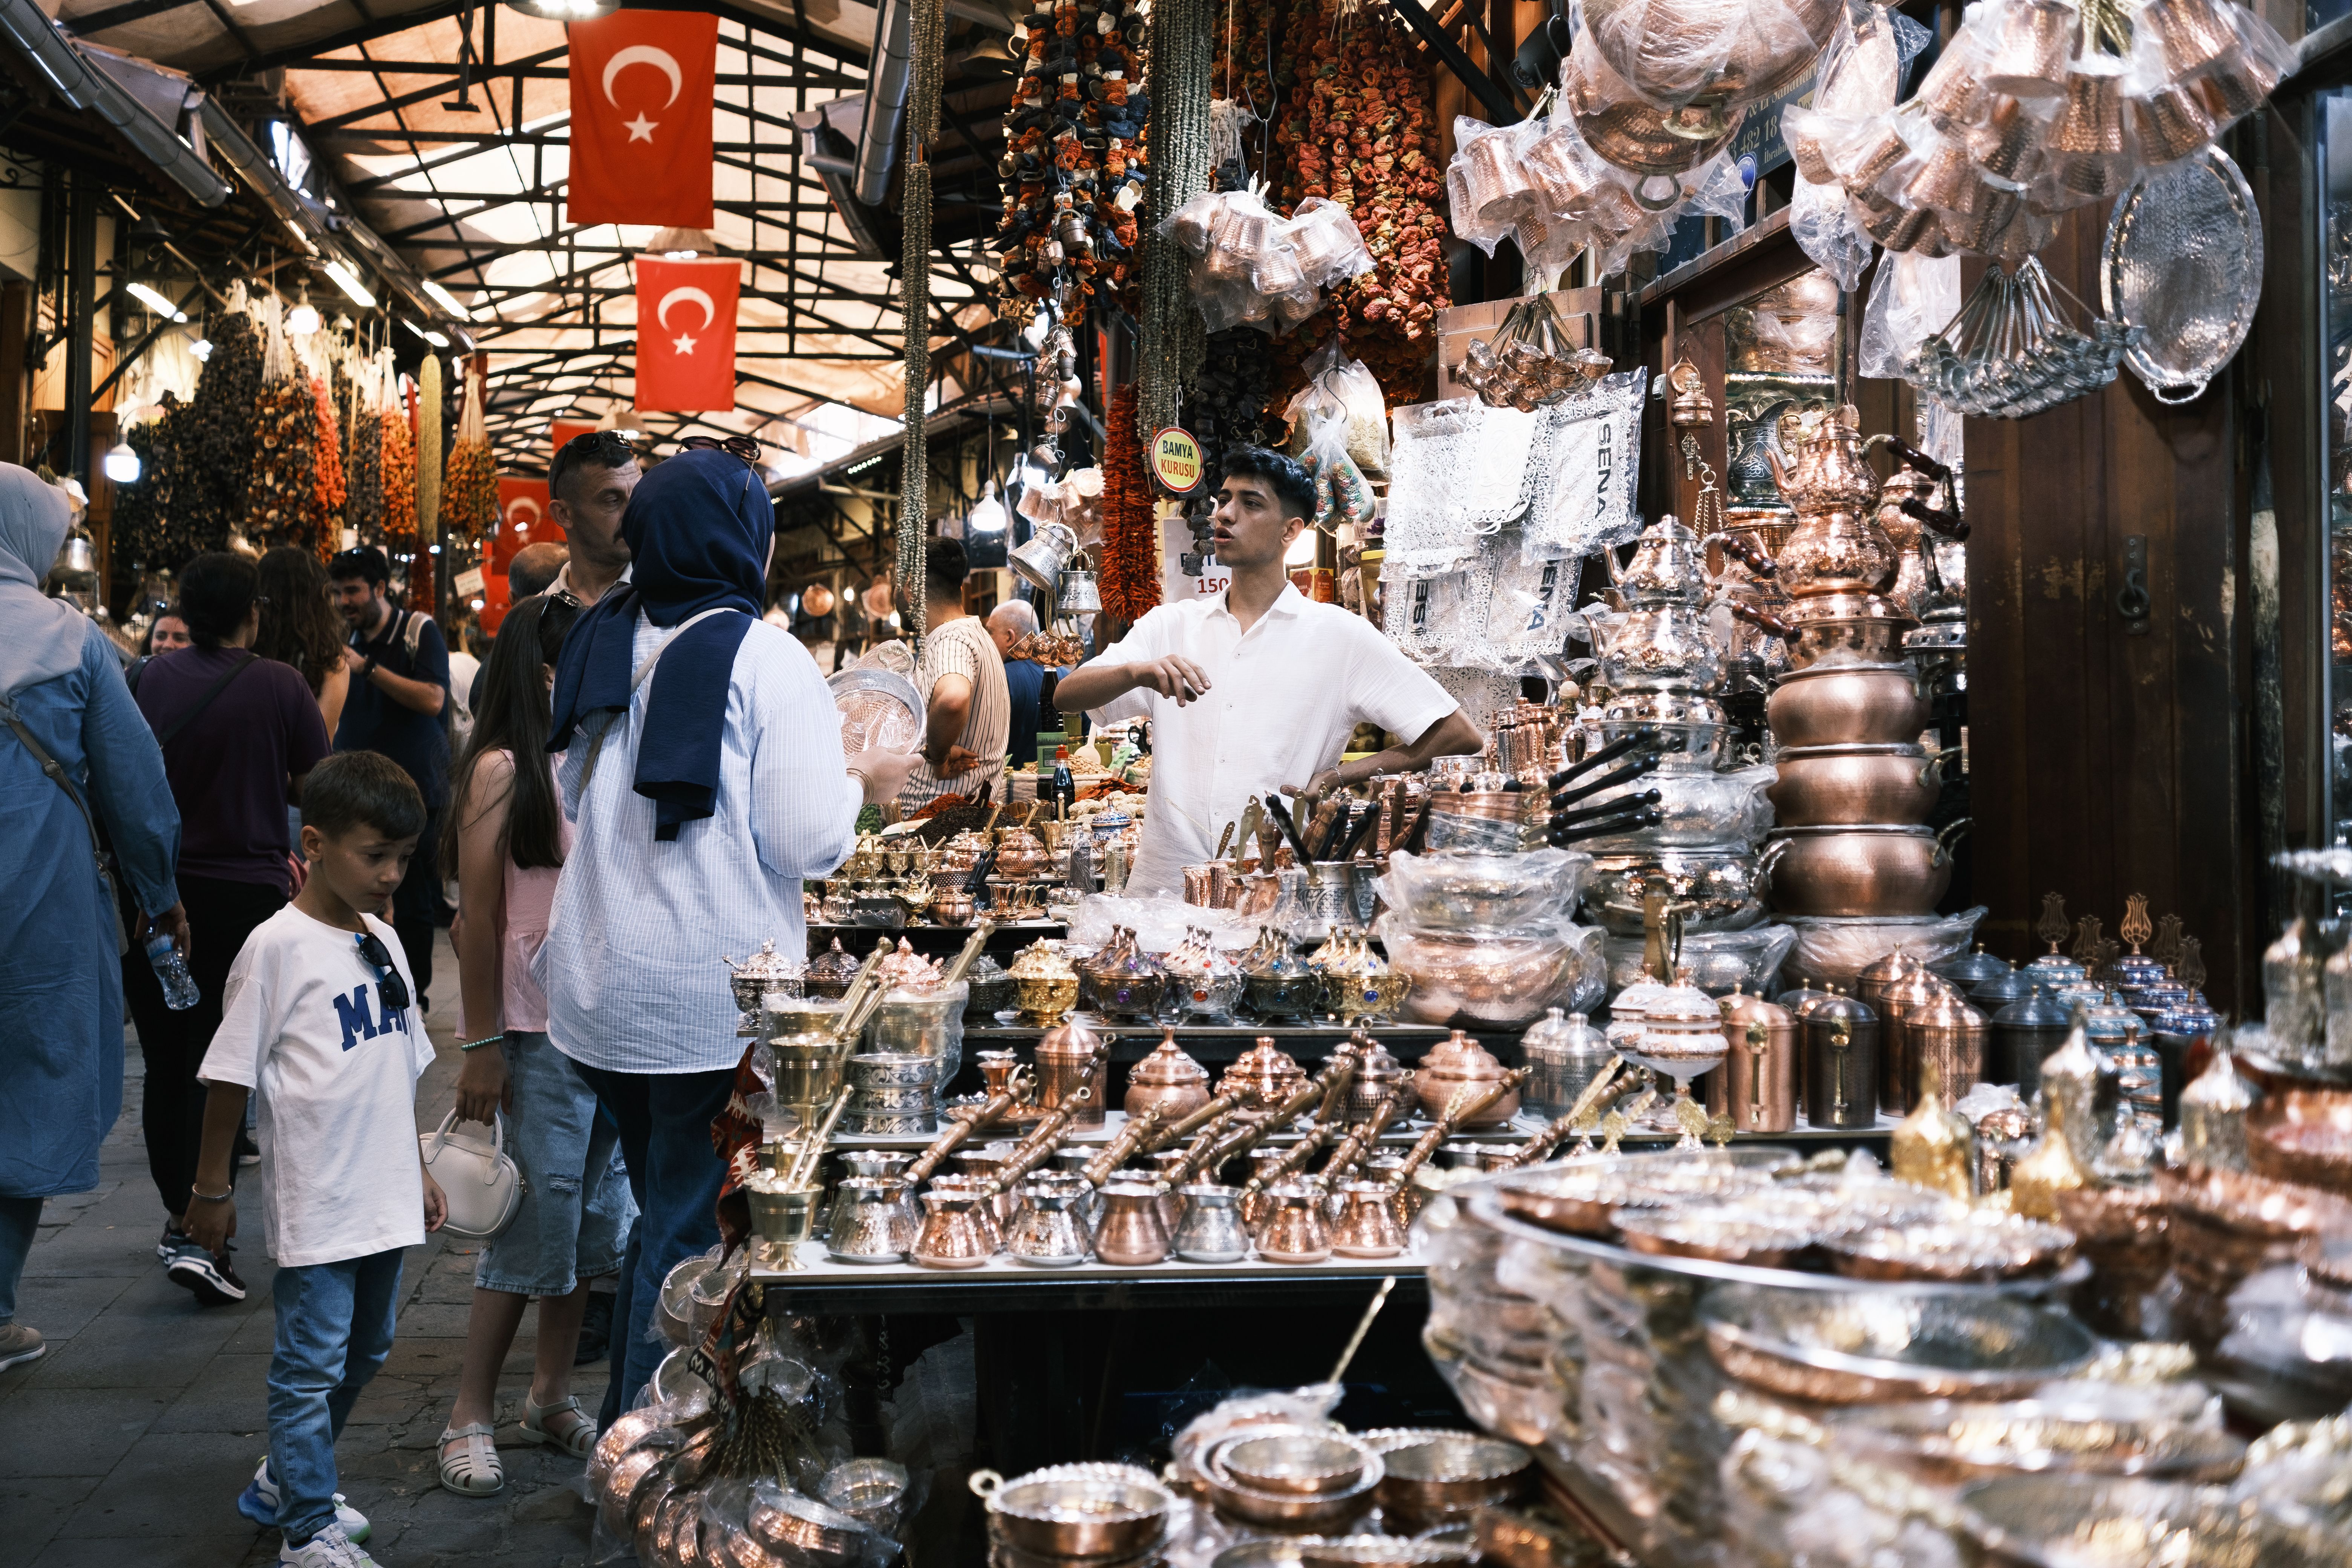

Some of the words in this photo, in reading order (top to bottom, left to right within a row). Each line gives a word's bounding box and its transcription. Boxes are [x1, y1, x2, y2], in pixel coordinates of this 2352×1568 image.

[1740, 126, 1760, 155] 482
[1764, 115, 1777, 142] 18
[1163, 440, 1193, 459] BAMYA
[1161, 458, 1195, 478] KURUSU
[1595, 423, 1611, 519] SENA
[1198, 577, 1229, 593] 150
